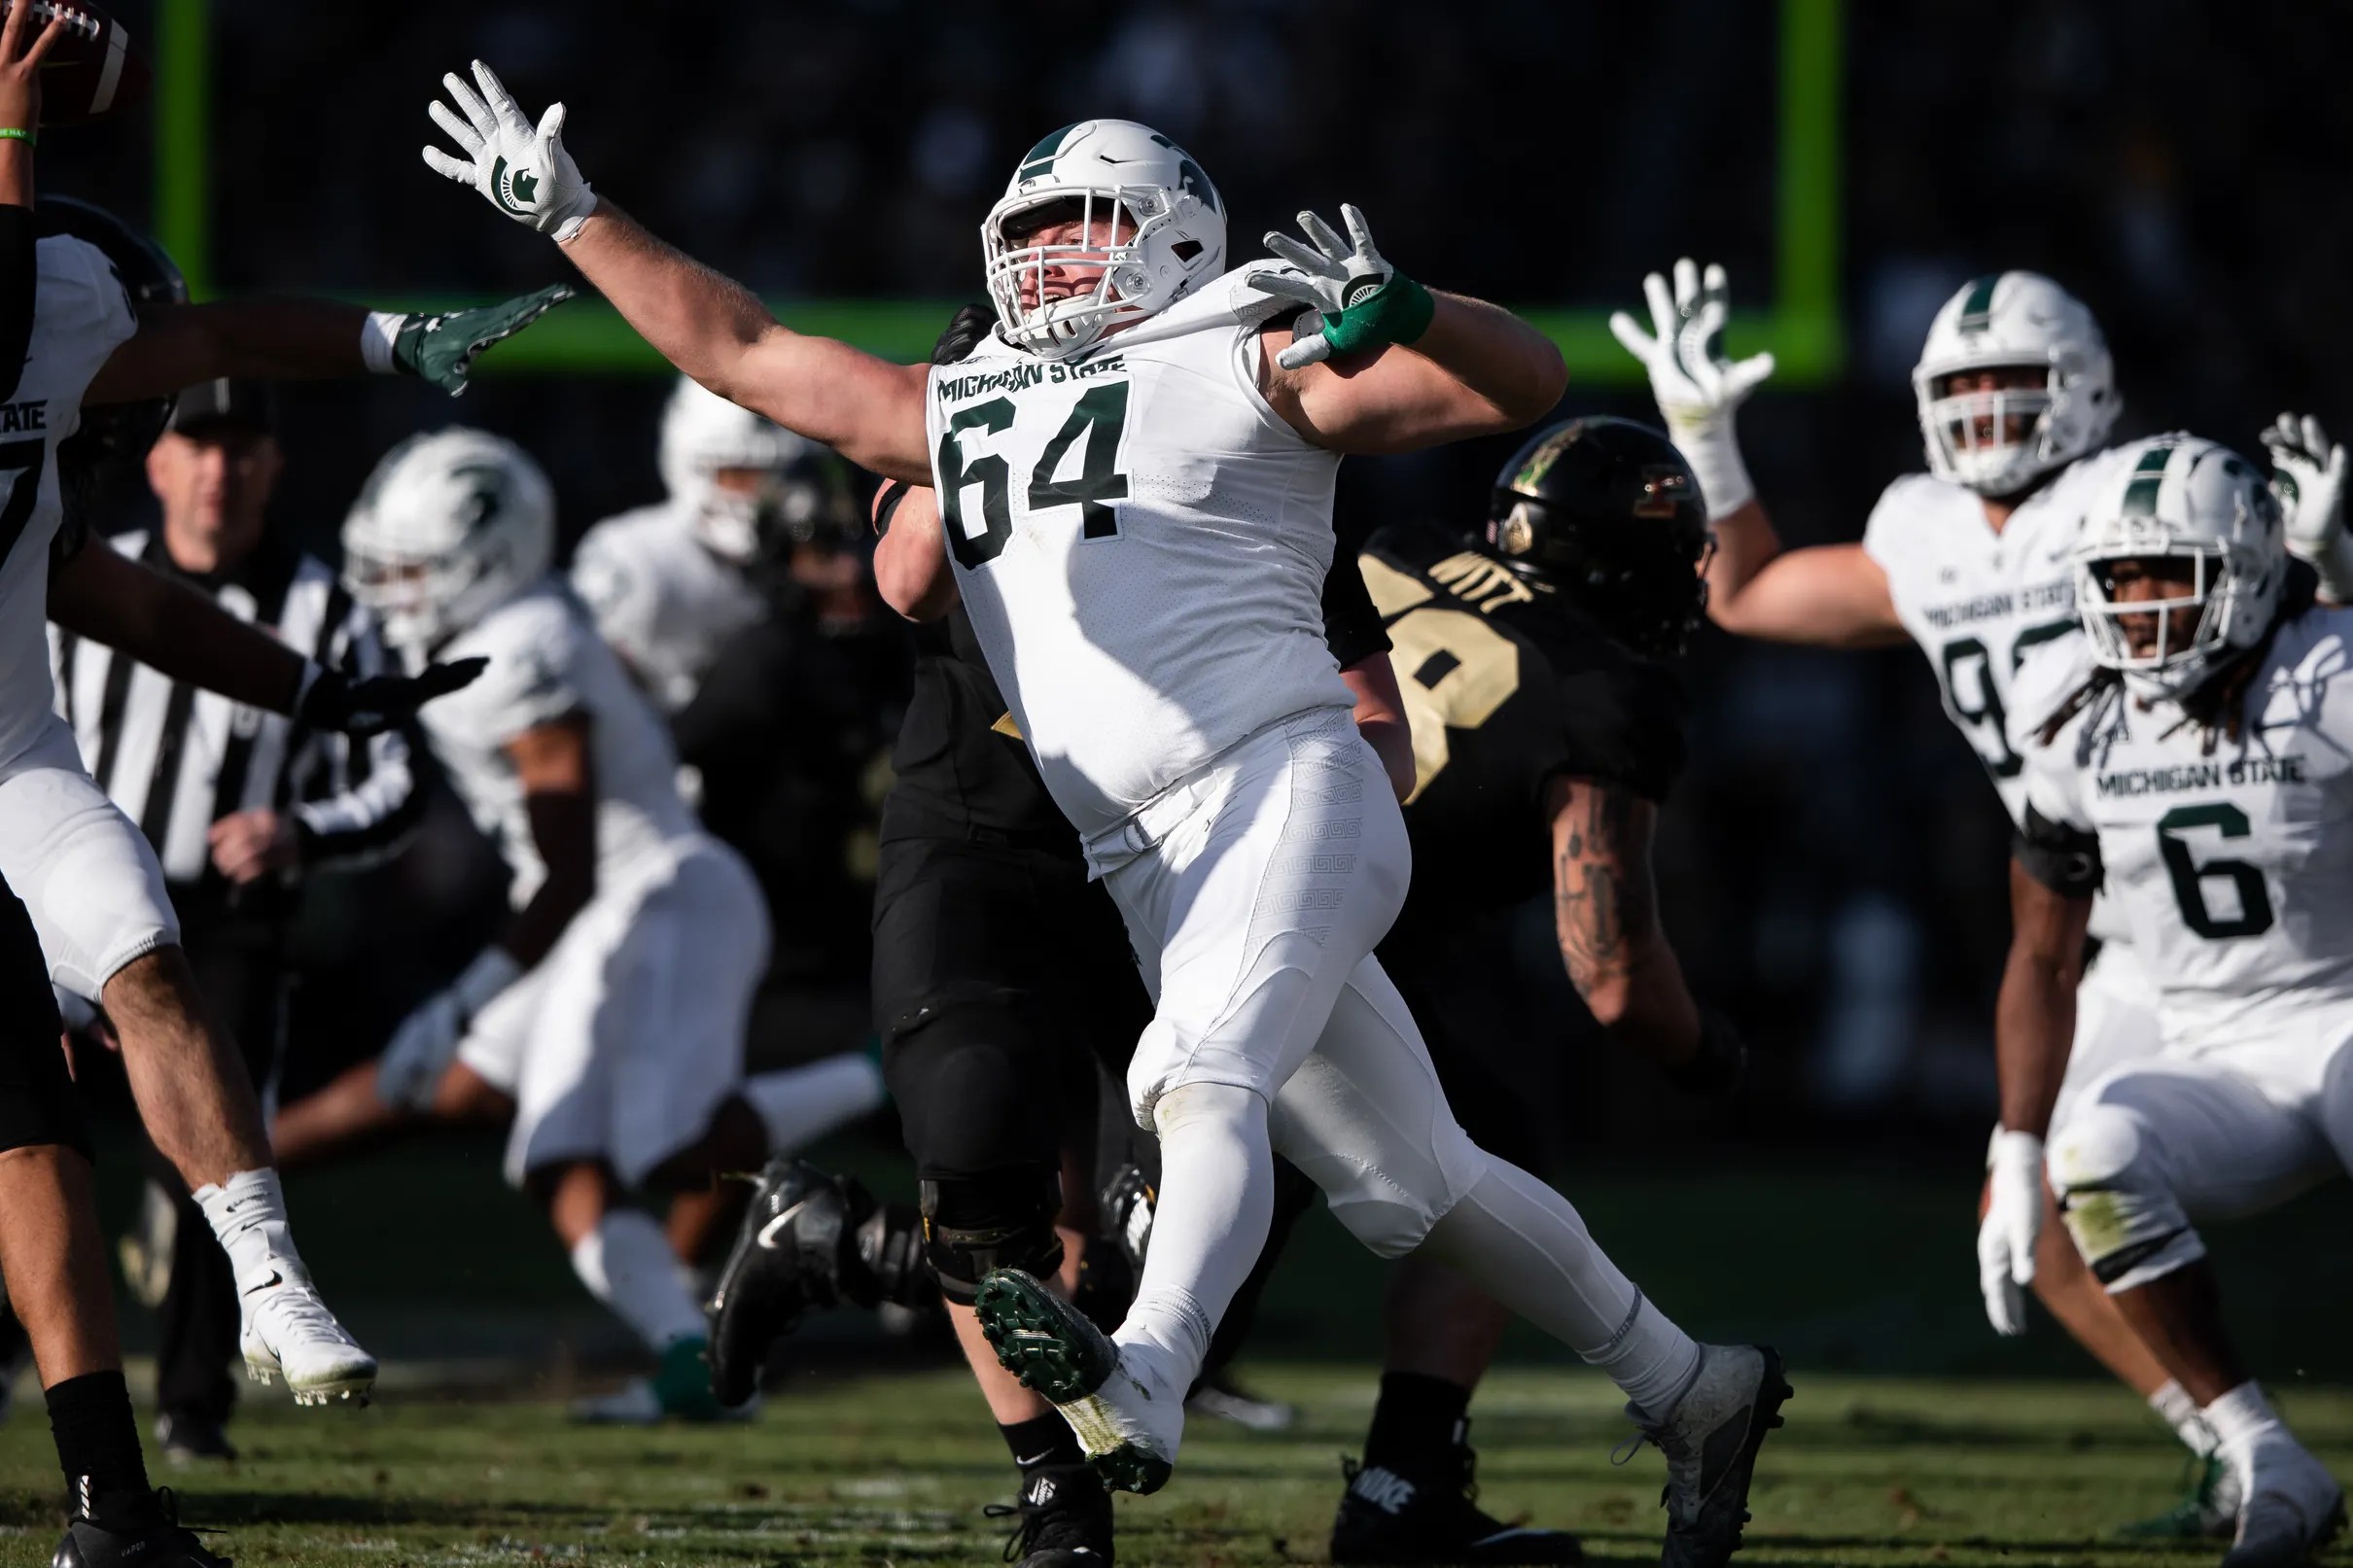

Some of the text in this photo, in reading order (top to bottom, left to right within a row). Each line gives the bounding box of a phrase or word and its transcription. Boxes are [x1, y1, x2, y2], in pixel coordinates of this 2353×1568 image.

[937, 347, 1128, 402] MICHIGAN STATE
[0, 400, 48, 434] ATE
[938, 380, 1130, 572] 64
[2097, 754, 2307, 798] MICHIGAN STATE
[2157, 802, 2274, 939] 6
